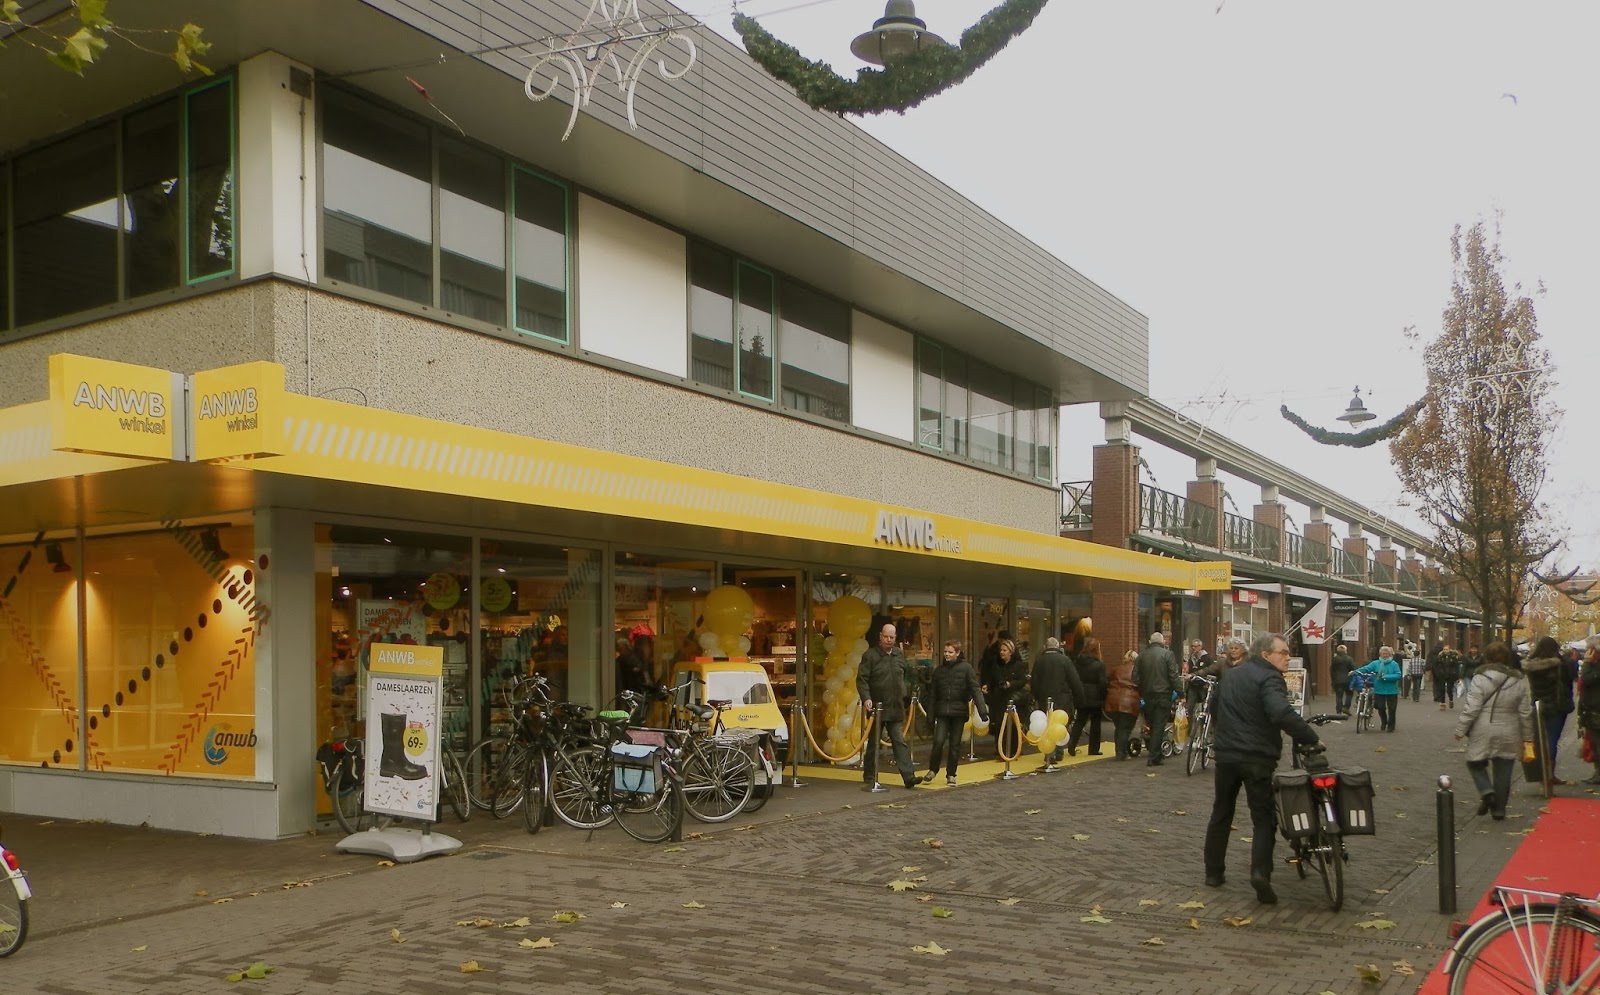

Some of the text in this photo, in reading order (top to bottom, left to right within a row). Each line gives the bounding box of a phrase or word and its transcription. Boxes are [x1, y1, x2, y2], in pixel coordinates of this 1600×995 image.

[73, 381, 166, 418] ANWB
[199, 387, 259, 420] ANWB
[119, 416, 166, 435] winkel
[226, 413, 259, 432] winkel
[874, 510, 962, 554] ANWB winkel
[1199, 569, 1227, 578] ANWB
[378, 650, 415, 665] ANWB
[376, 682, 433, 695] DAMESLAARZEN
[215, 729, 258, 748] anwb
